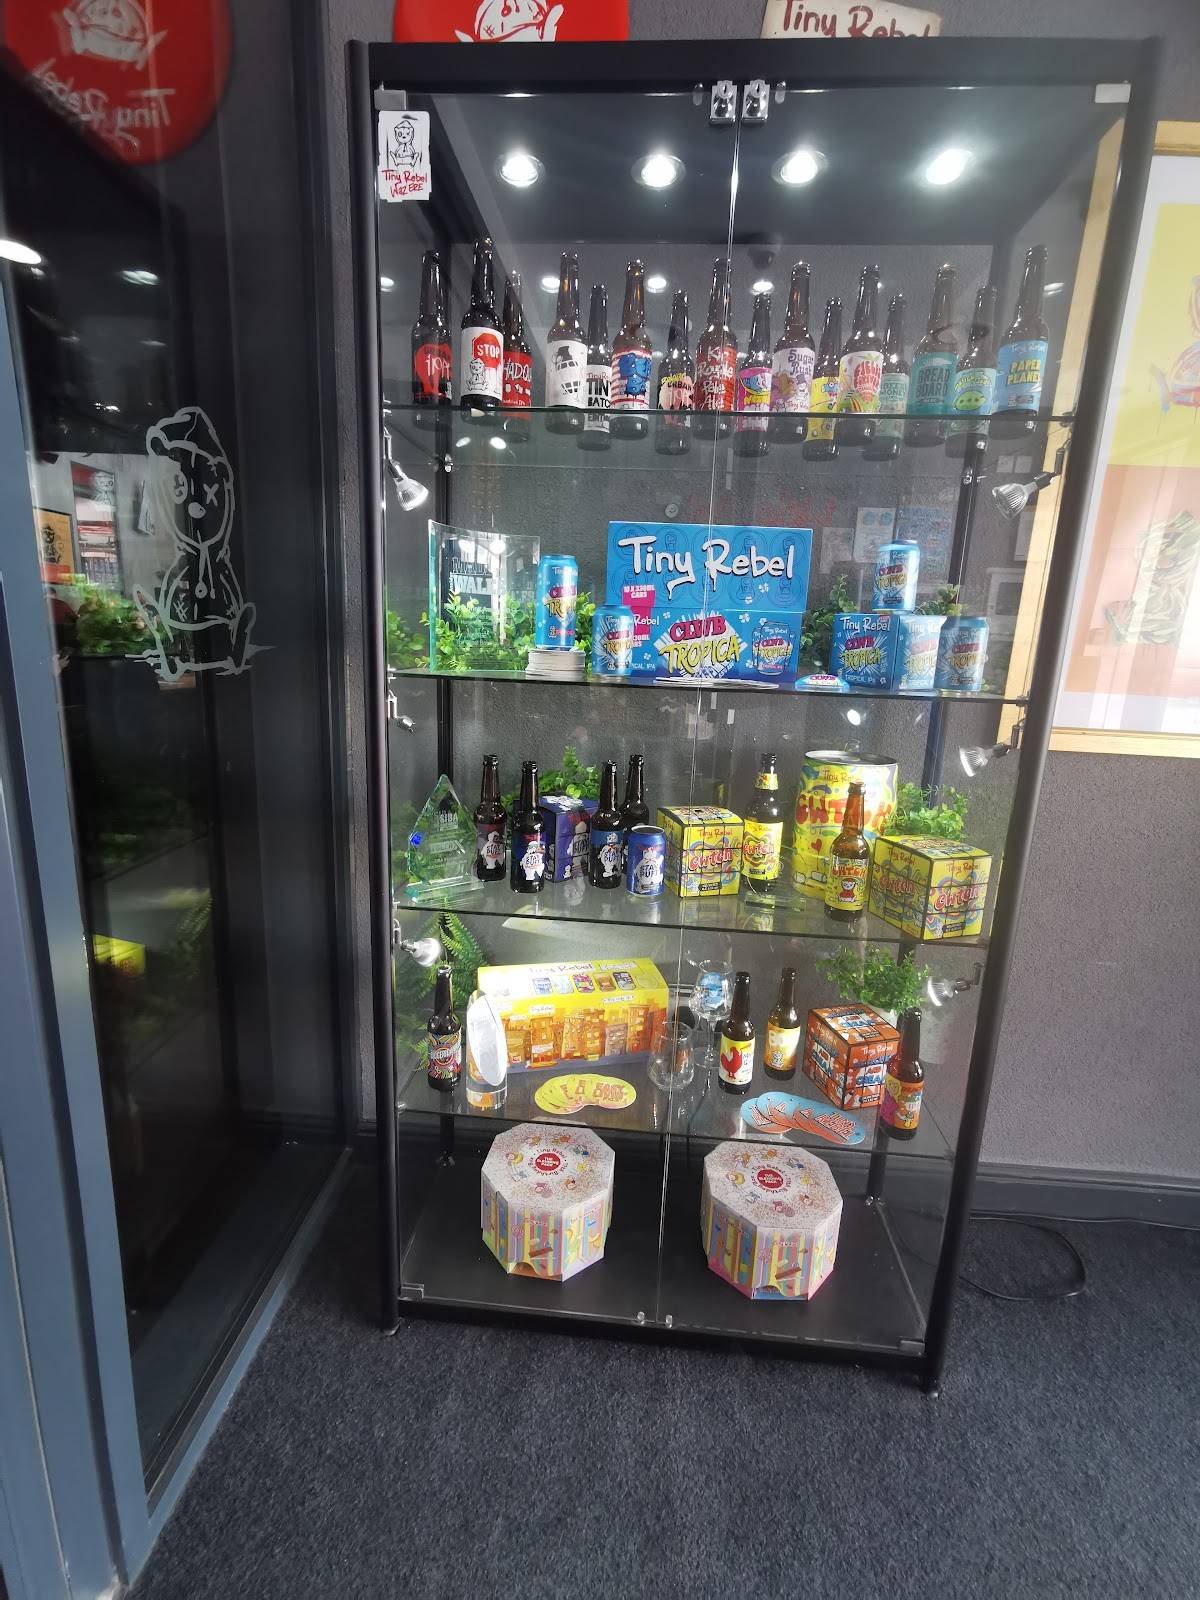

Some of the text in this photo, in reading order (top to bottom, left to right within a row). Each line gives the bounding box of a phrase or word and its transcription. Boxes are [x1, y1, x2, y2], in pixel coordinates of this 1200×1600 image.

[381, 169, 428, 184] Tiny Rebel
[477, 344, 500, 359] STOP
[588, 396, 612, 409] BATC
[618, 535, 794, 600] Tiny Rebel
[633, 614, 660, 629] Rebel
[840, 616, 891, 638] Tiny Rebel
[658, 635, 743, 675] TROPICA
